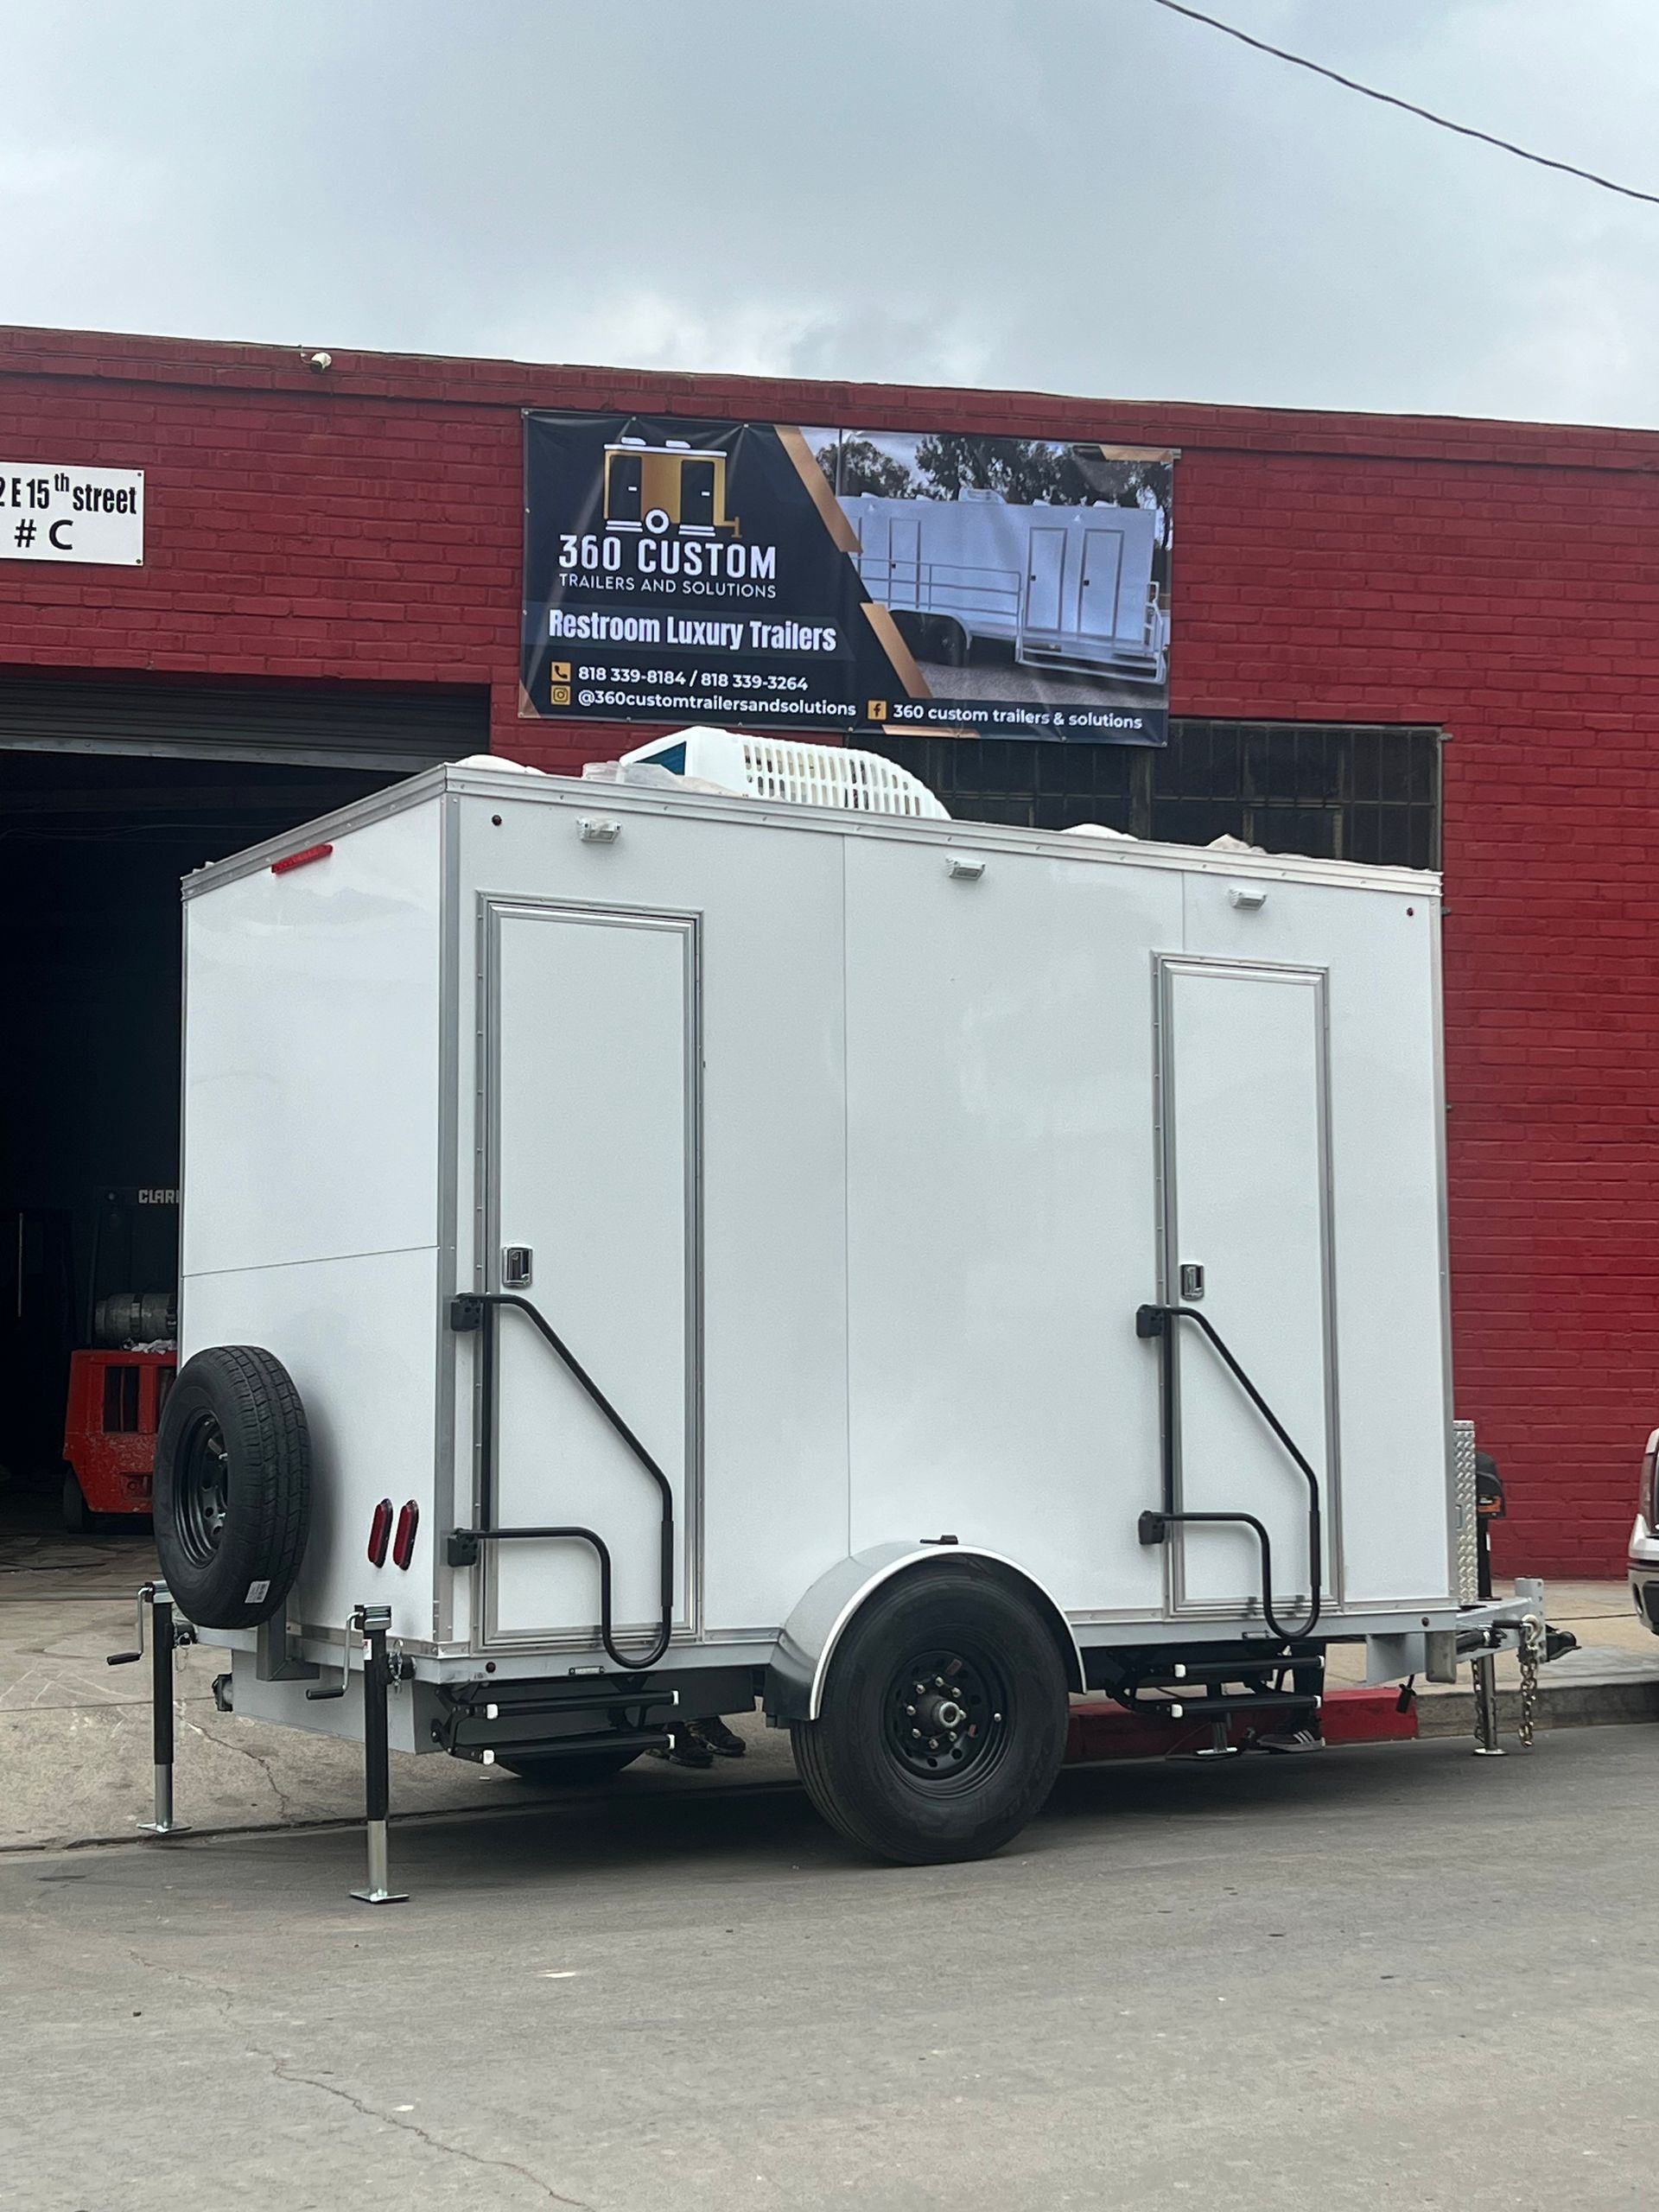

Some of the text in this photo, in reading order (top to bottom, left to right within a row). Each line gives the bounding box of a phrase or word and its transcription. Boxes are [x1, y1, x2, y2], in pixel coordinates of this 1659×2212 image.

[11, 478, 22, 507] E
[73, 484, 137, 515] street
[14, 518, 74, 550] # C
[558, 534, 777, 580] 360 CUSTOM
[559, 573, 777, 599] TRAILERS AND SOLUTIONS
[549, 609, 836, 652] Restroom Luxury Trailers
[578, 666, 809, 691] 818 339-8184 / 818 339-3264
[578, 690, 857, 716] @360customtrailersandsolutions
[893, 705, 924, 720] 360
[928, 707, 988, 722] custom
[992, 709, 1050, 726] trailers
[1052, 712, 1065, 726] &
[1068, 713, 1143, 730] solutions
